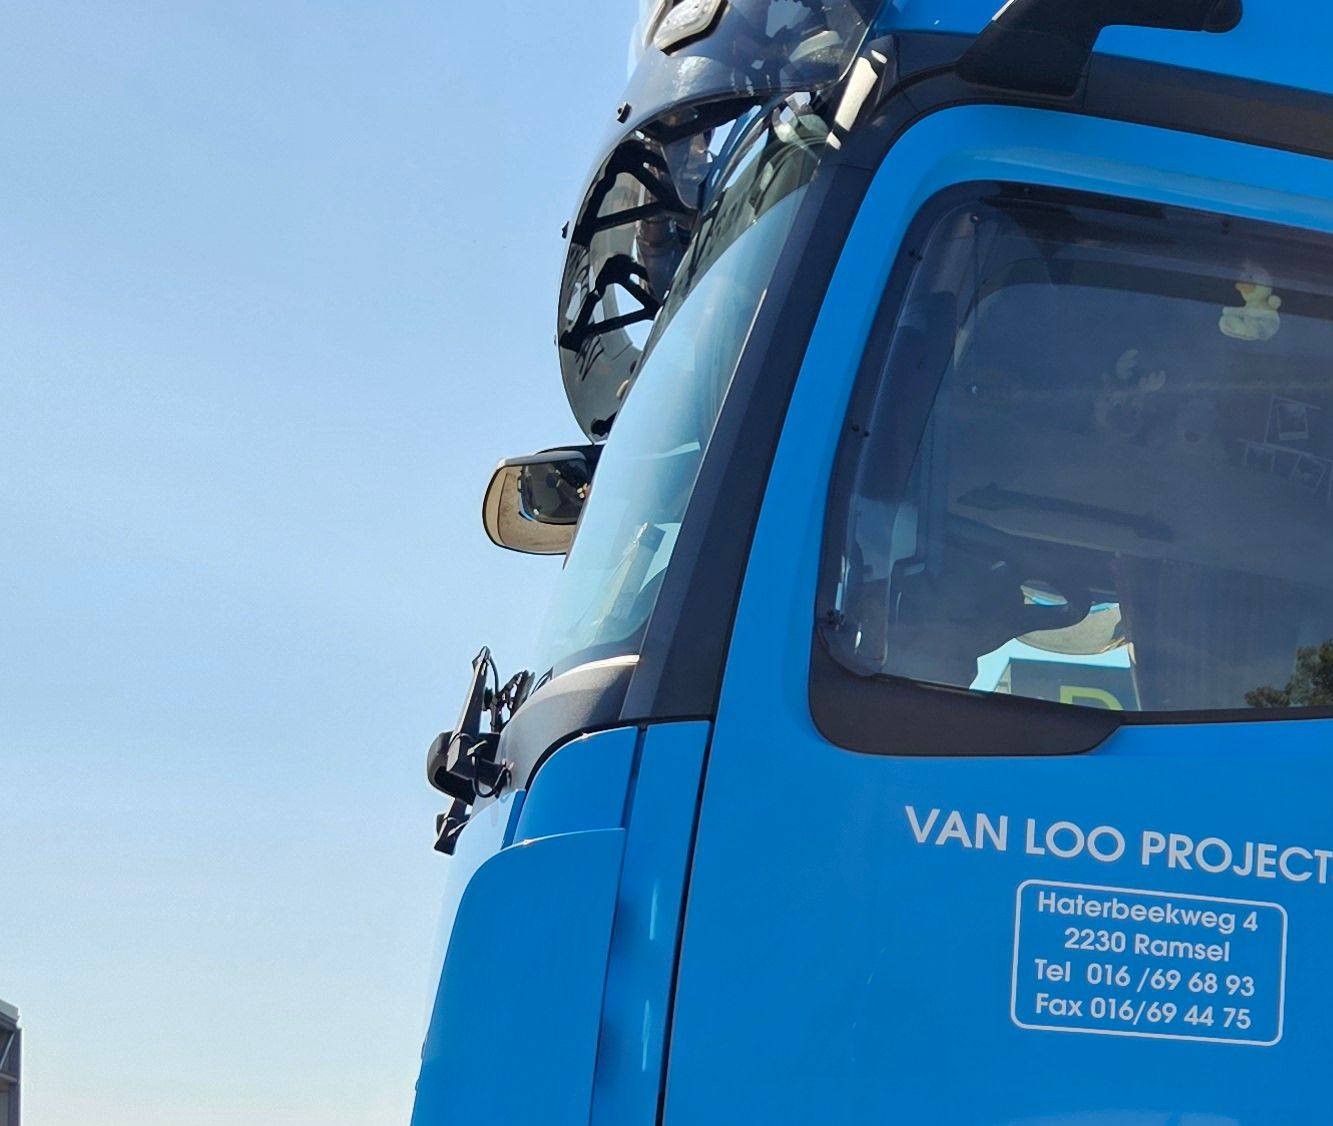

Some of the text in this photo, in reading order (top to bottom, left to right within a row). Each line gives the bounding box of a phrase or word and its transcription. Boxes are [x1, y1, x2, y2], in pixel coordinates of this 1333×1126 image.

[905, 805, 1009, 851] VAN
[1025, 818, 1126, 863] LOO
[1038, 891, 1258, 935] Haterbeekweg 4
[1064, 927, 1230, 962] 2230 Ramsel
[1034, 958, 1071, 982] Tel
[1086, 963, 1131, 987] 016
[1188, 972, 1218, 994] 68
[1225, 974, 1255, 997] 93
[1035, 992, 1251, 1030] Fax 016/69 44 75
